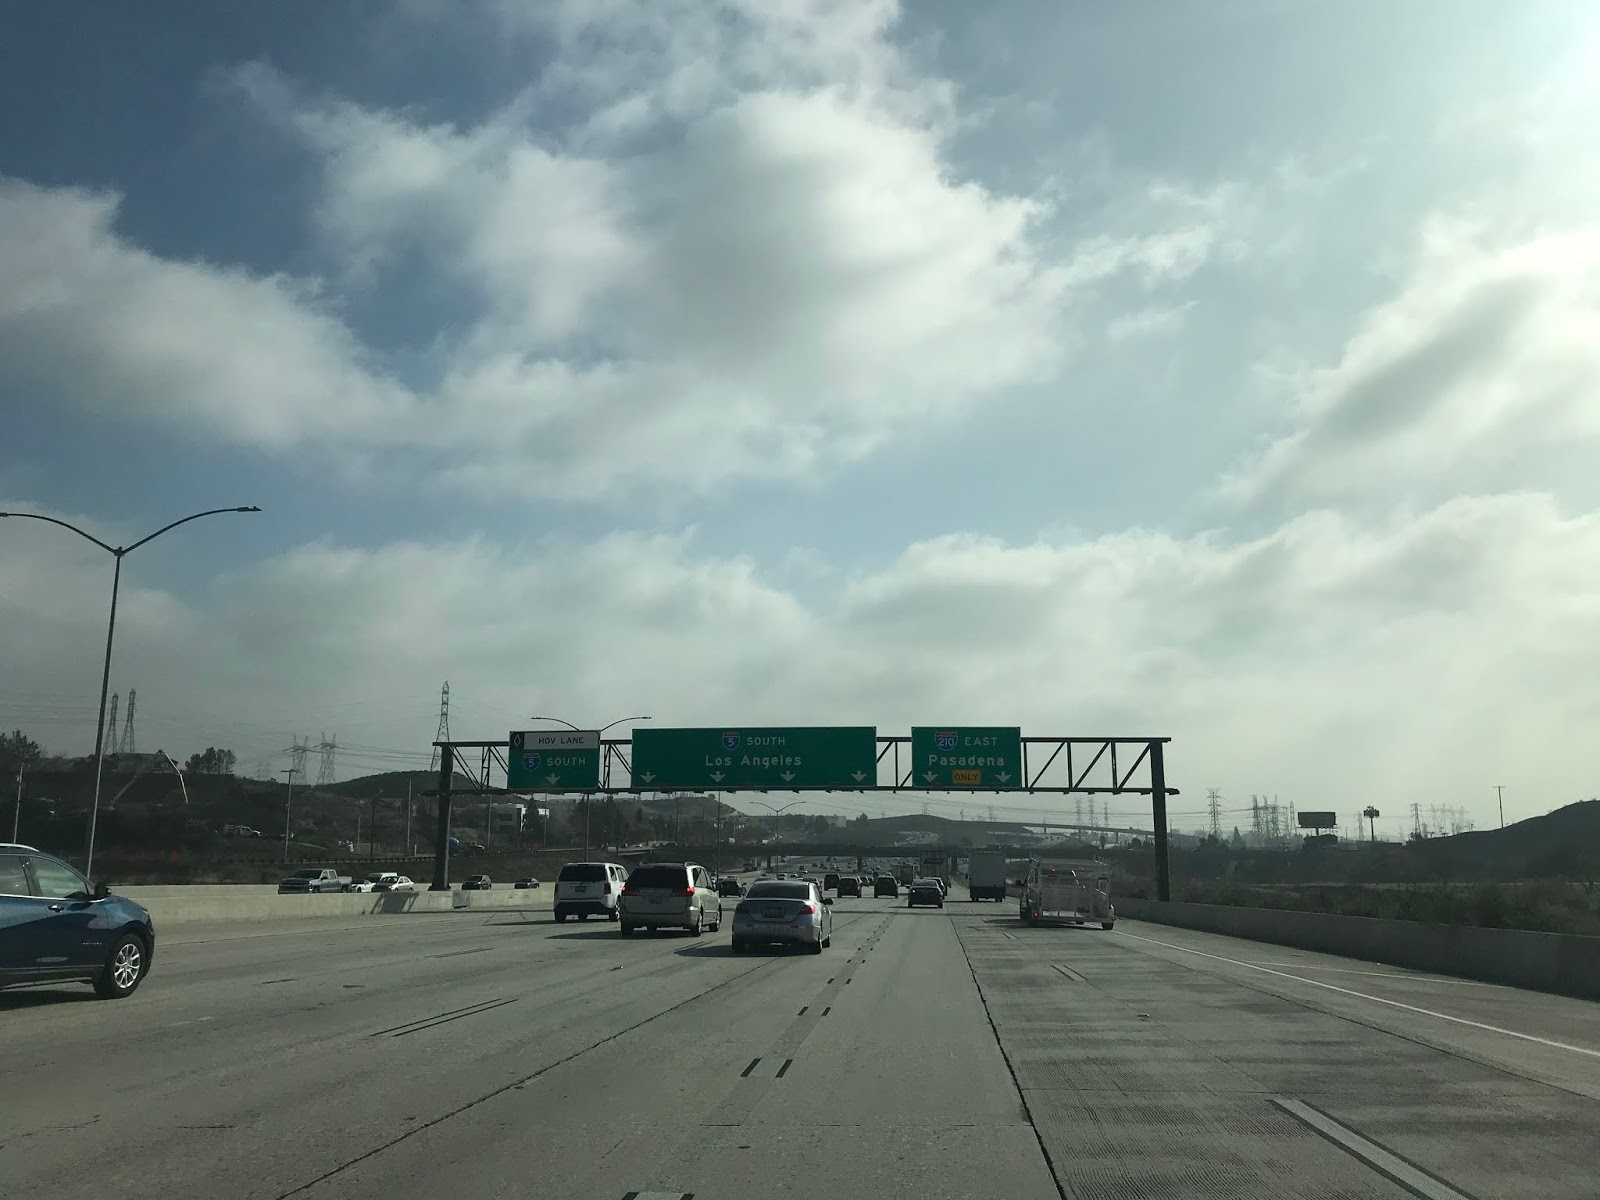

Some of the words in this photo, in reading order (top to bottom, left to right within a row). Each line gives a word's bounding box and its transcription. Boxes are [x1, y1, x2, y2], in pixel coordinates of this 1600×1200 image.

[728, 738, 735, 747] 5
[746, 737, 786, 746] SOUTH
[938, 737, 955, 747] 210
[964, 737, 997, 746] EAST
[528, 759, 534, 767] 5
[547, 757, 586, 767] SOUTH
[705, 755, 732, 766] Los
[740, 754, 802, 769] Angeles
[928, 754, 1005, 766] Pasadena
[954, 773, 979, 781] ONLY
